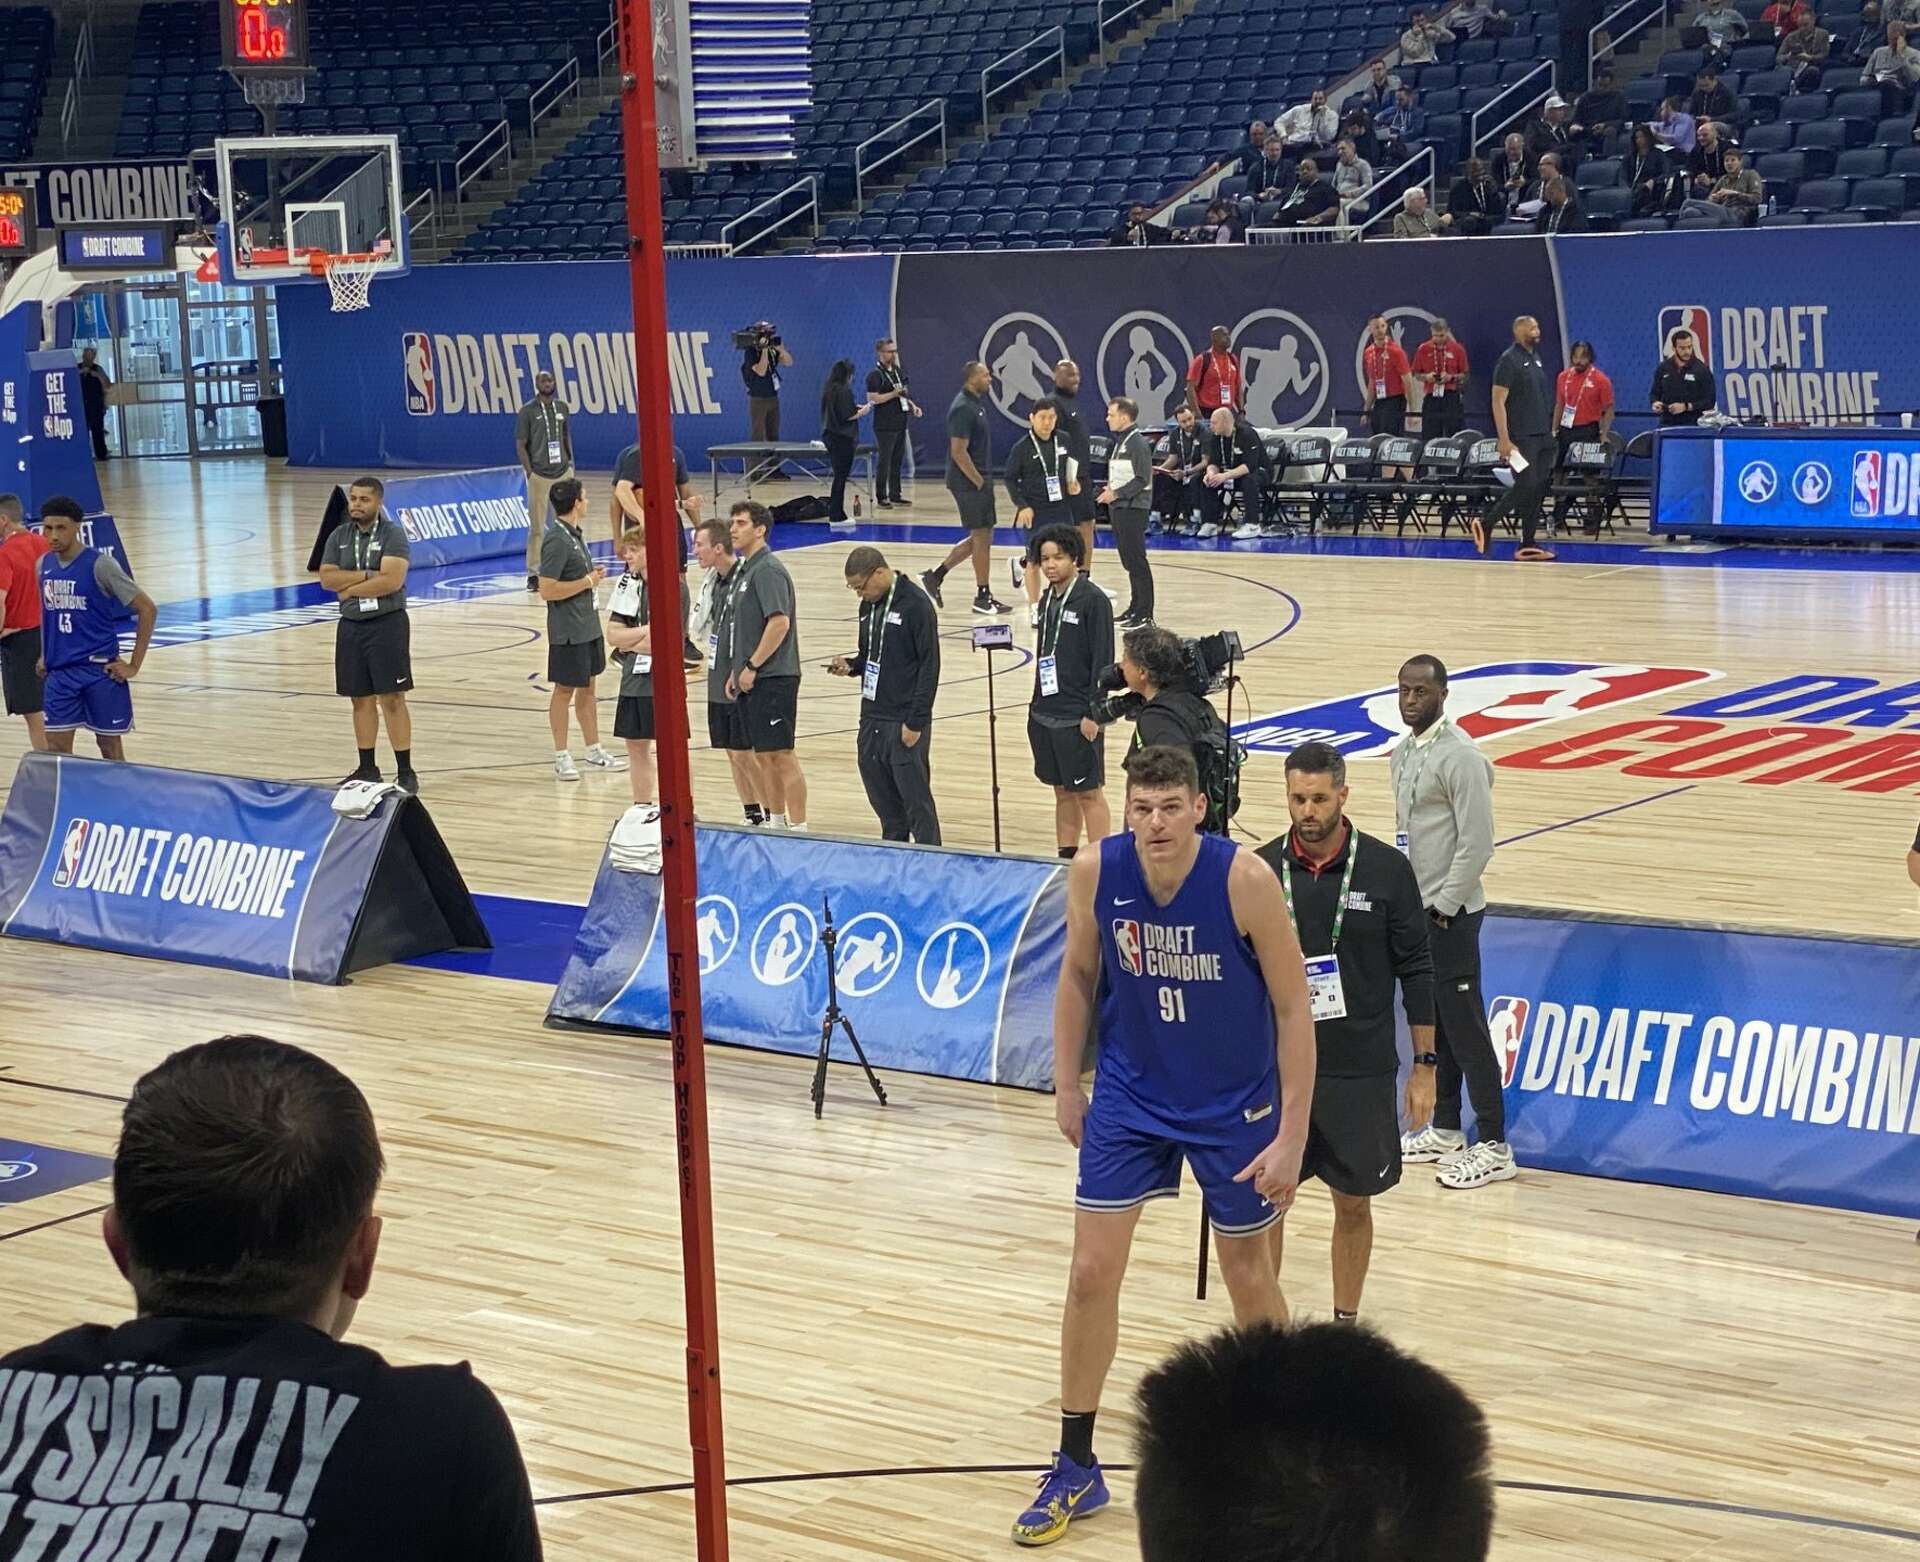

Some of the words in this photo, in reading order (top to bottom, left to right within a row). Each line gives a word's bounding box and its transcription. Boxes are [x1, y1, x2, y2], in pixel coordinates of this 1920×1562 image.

[50, 166, 196, 223] COMBINE
[89, 237, 111, 257] DRAFT
[1721, 306, 1828, 370] DRAFT
[45, 372, 65, 393] GET
[434, 334, 541, 415] DRAFT
[549, 332, 722, 415] COMNE
[46, 394, 67, 415] THE
[1724, 372, 1883, 427] COMBINE
[54, 416, 73, 440] App
[410, 503, 468, 540] DRAFT
[461, 496, 531, 534] COMBINE
[53, 580, 77, 596] DRAFT
[58, 613, 73, 633] 43
[1657, 674, 1920, 729] DR
[1494, 720, 1920, 796] COM
[76, 822, 172, 897] DRAFT
[160, 832, 305, 919] COMBINE
[1349, 891, 1367, 901] DRAFT
[1143, 922, 1195, 954] DRAFT
[1146, 950, 1223, 982] COMBINE
[1158, 987, 1186, 1023] 91
[1520, 1001, 1694, 1105] DRAFT
